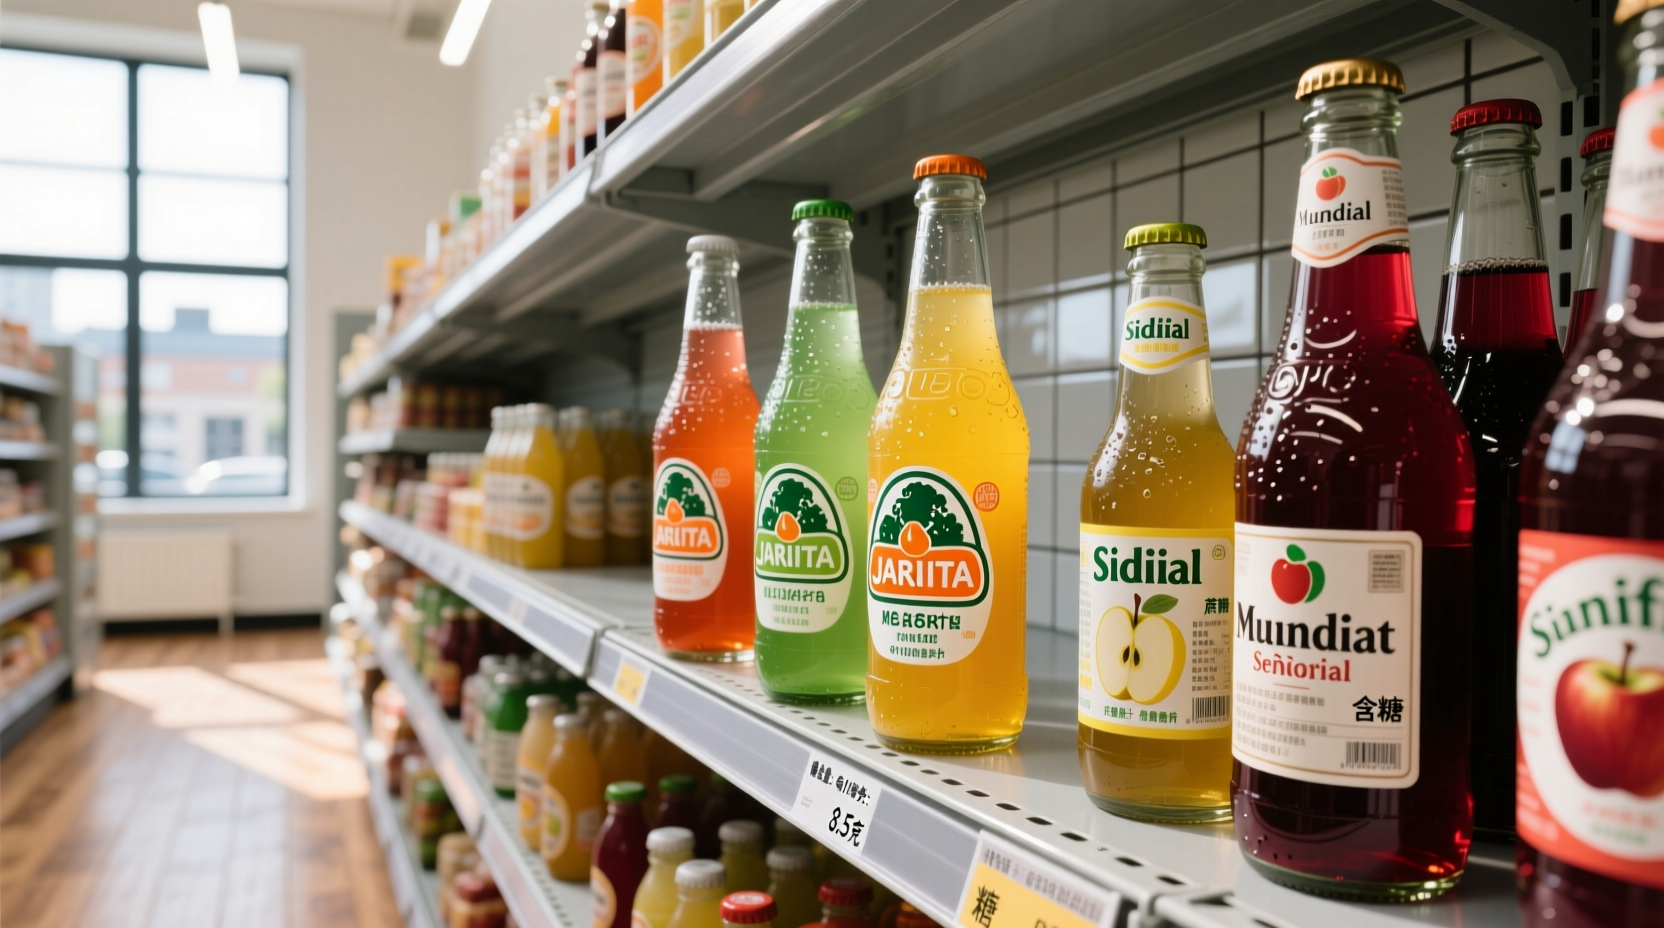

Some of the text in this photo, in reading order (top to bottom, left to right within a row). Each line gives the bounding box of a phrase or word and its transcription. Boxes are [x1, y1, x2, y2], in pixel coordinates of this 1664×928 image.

[1125, 317, 1190, 341] Sidiial
[872, 556, 975, 589] JARIITA
[1093, 546, 1202, 585] Sidiial
[1352, 695, 1404, 723] 含糖
